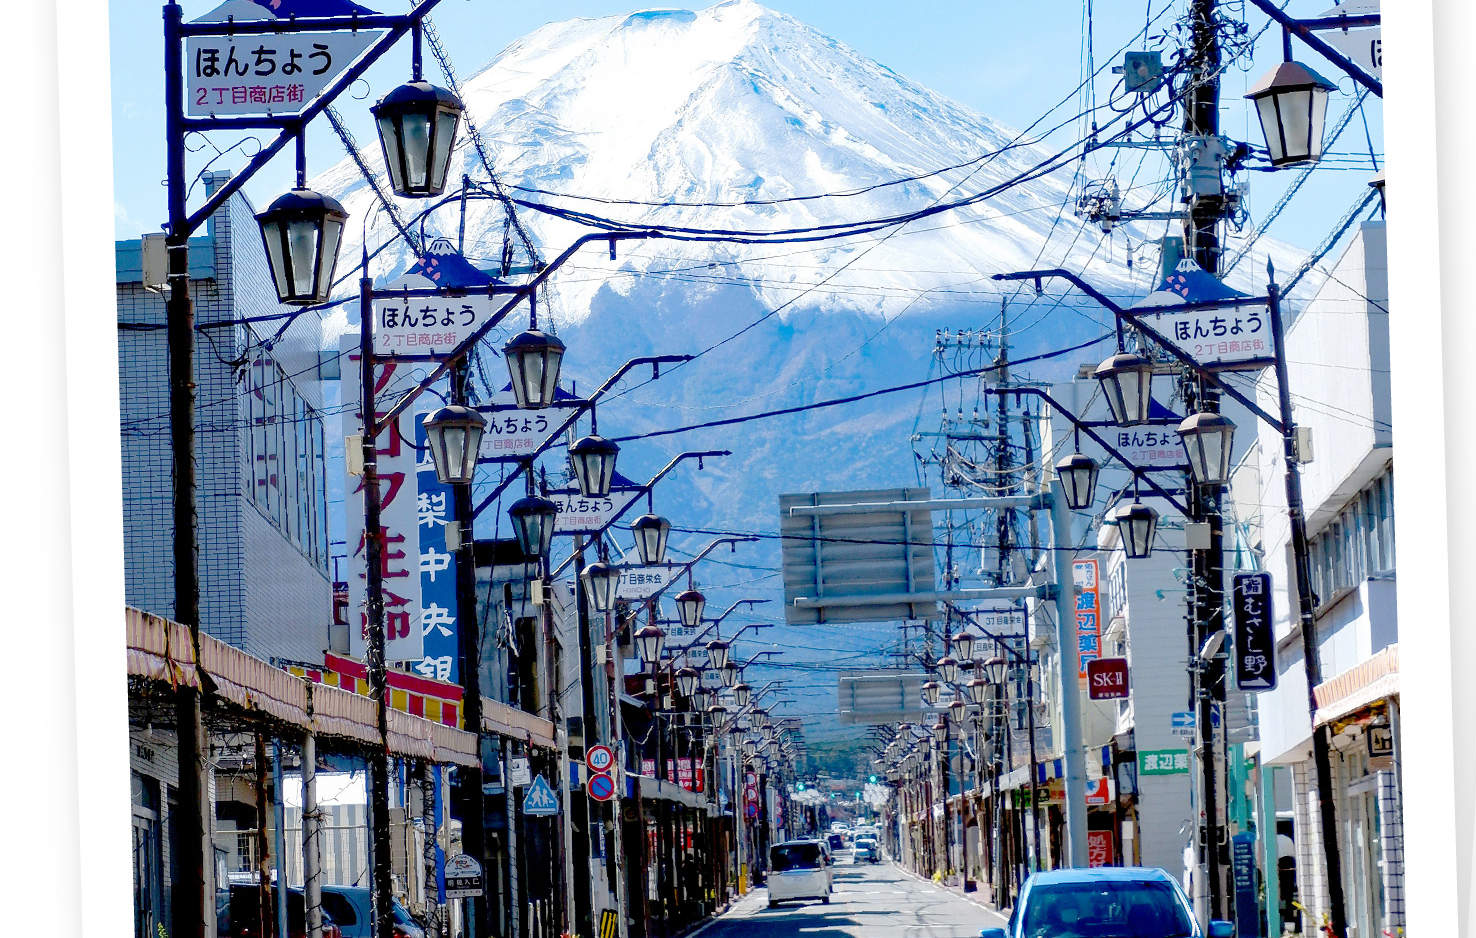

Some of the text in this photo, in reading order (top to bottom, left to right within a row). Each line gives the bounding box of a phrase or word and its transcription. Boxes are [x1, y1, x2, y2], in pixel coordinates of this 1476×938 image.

[196, 44, 332, 77] ほんちょう
[196, 84, 304, 105] 2丁目商店街
[382, 305, 475, 328] ほんちょう
[1175, 312, 1263, 341] ほんちょう
[382, 333, 457, 346] 2丁目商店街
[1195, 341, 1264, 356] 2丁目商店街
[484, 415, 548, 434] んちょう
[484, 439, 534, 450] 丁目商店街
[593, 752, 607, 765] 40
